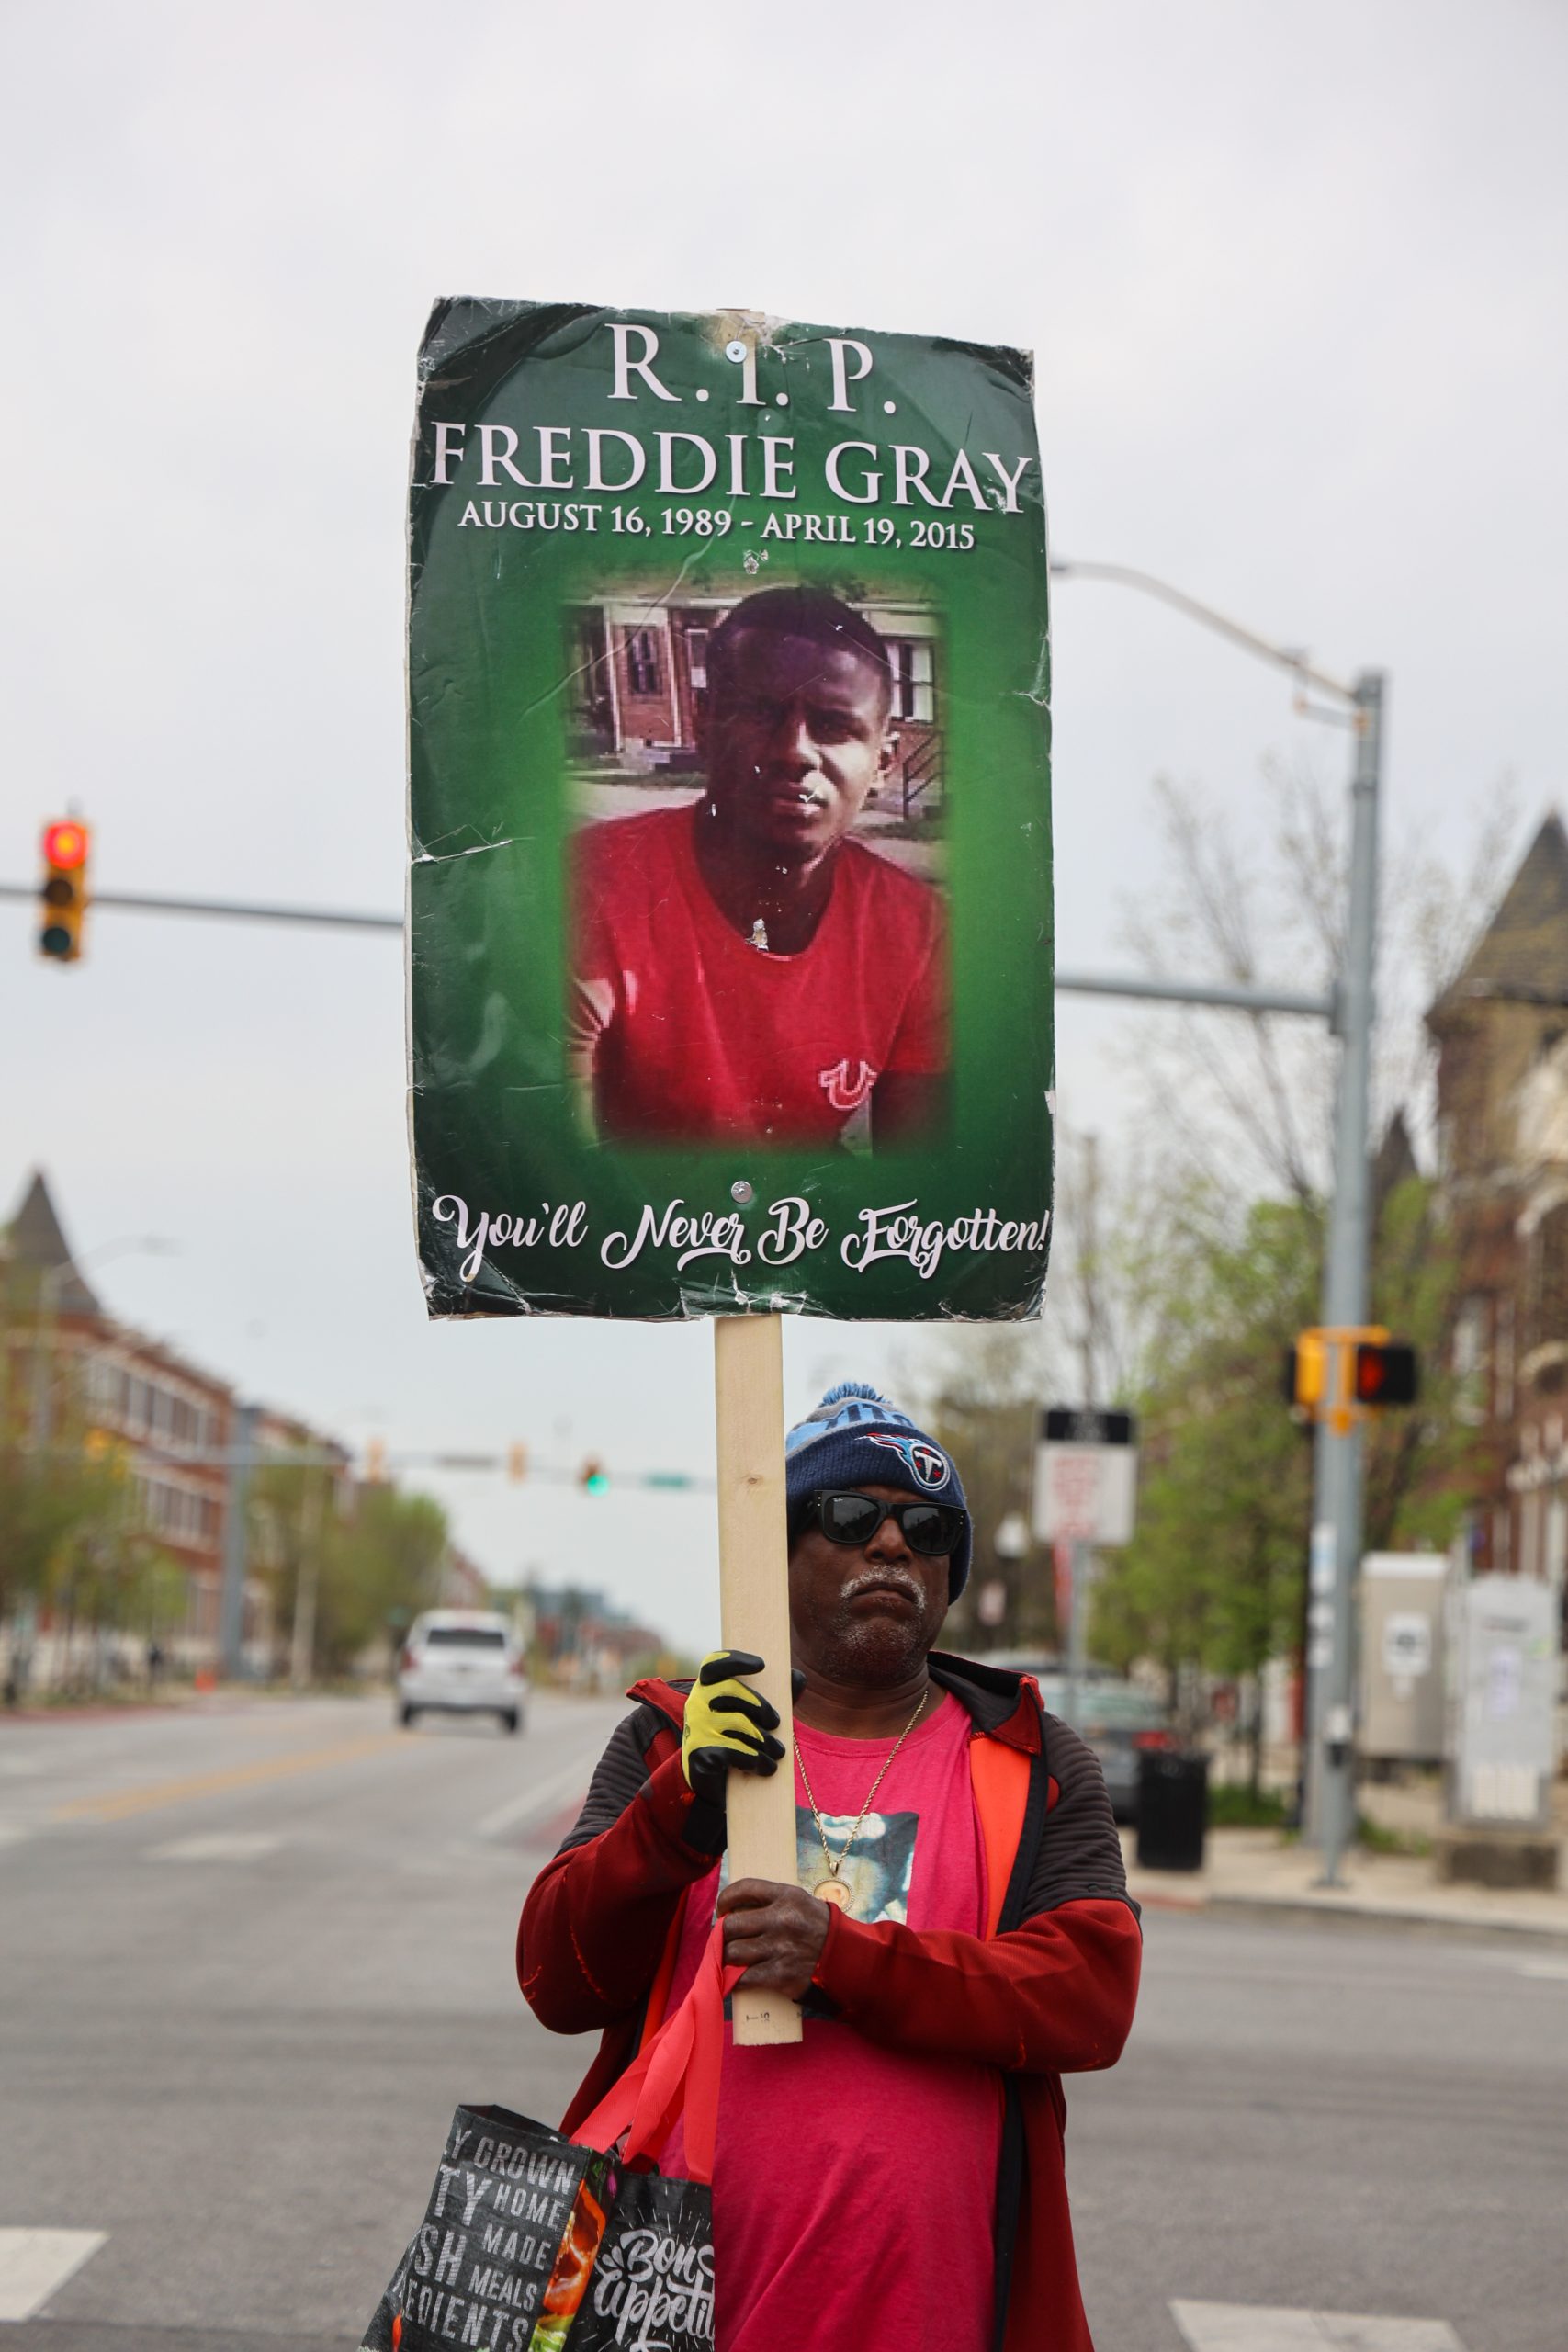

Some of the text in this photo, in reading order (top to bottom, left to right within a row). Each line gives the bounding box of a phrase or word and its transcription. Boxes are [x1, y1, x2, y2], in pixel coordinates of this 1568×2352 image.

[430, 421, 1032, 514] FREDDIE GRAY
[457, 500, 602, 531] AUGUST
[611, 505, 651, 537] 16,
[660, 508, 732, 537] 1989
[760, 512, 856, 543] APRIL
[863, 517, 902, 548] 19,
[909, 520, 975, 549] 2015
[431, 1194, 1049, 1283] You'll Never Be Forgotten!
[444, 2127, 576, 2195] Y GROWN
[492, 2182, 565, 2232] HOME
[410, 2222, 467, 2287] SH
[481, 2222, 552, 2271] MADE
[468, 2264, 538, 2312] MEALS
